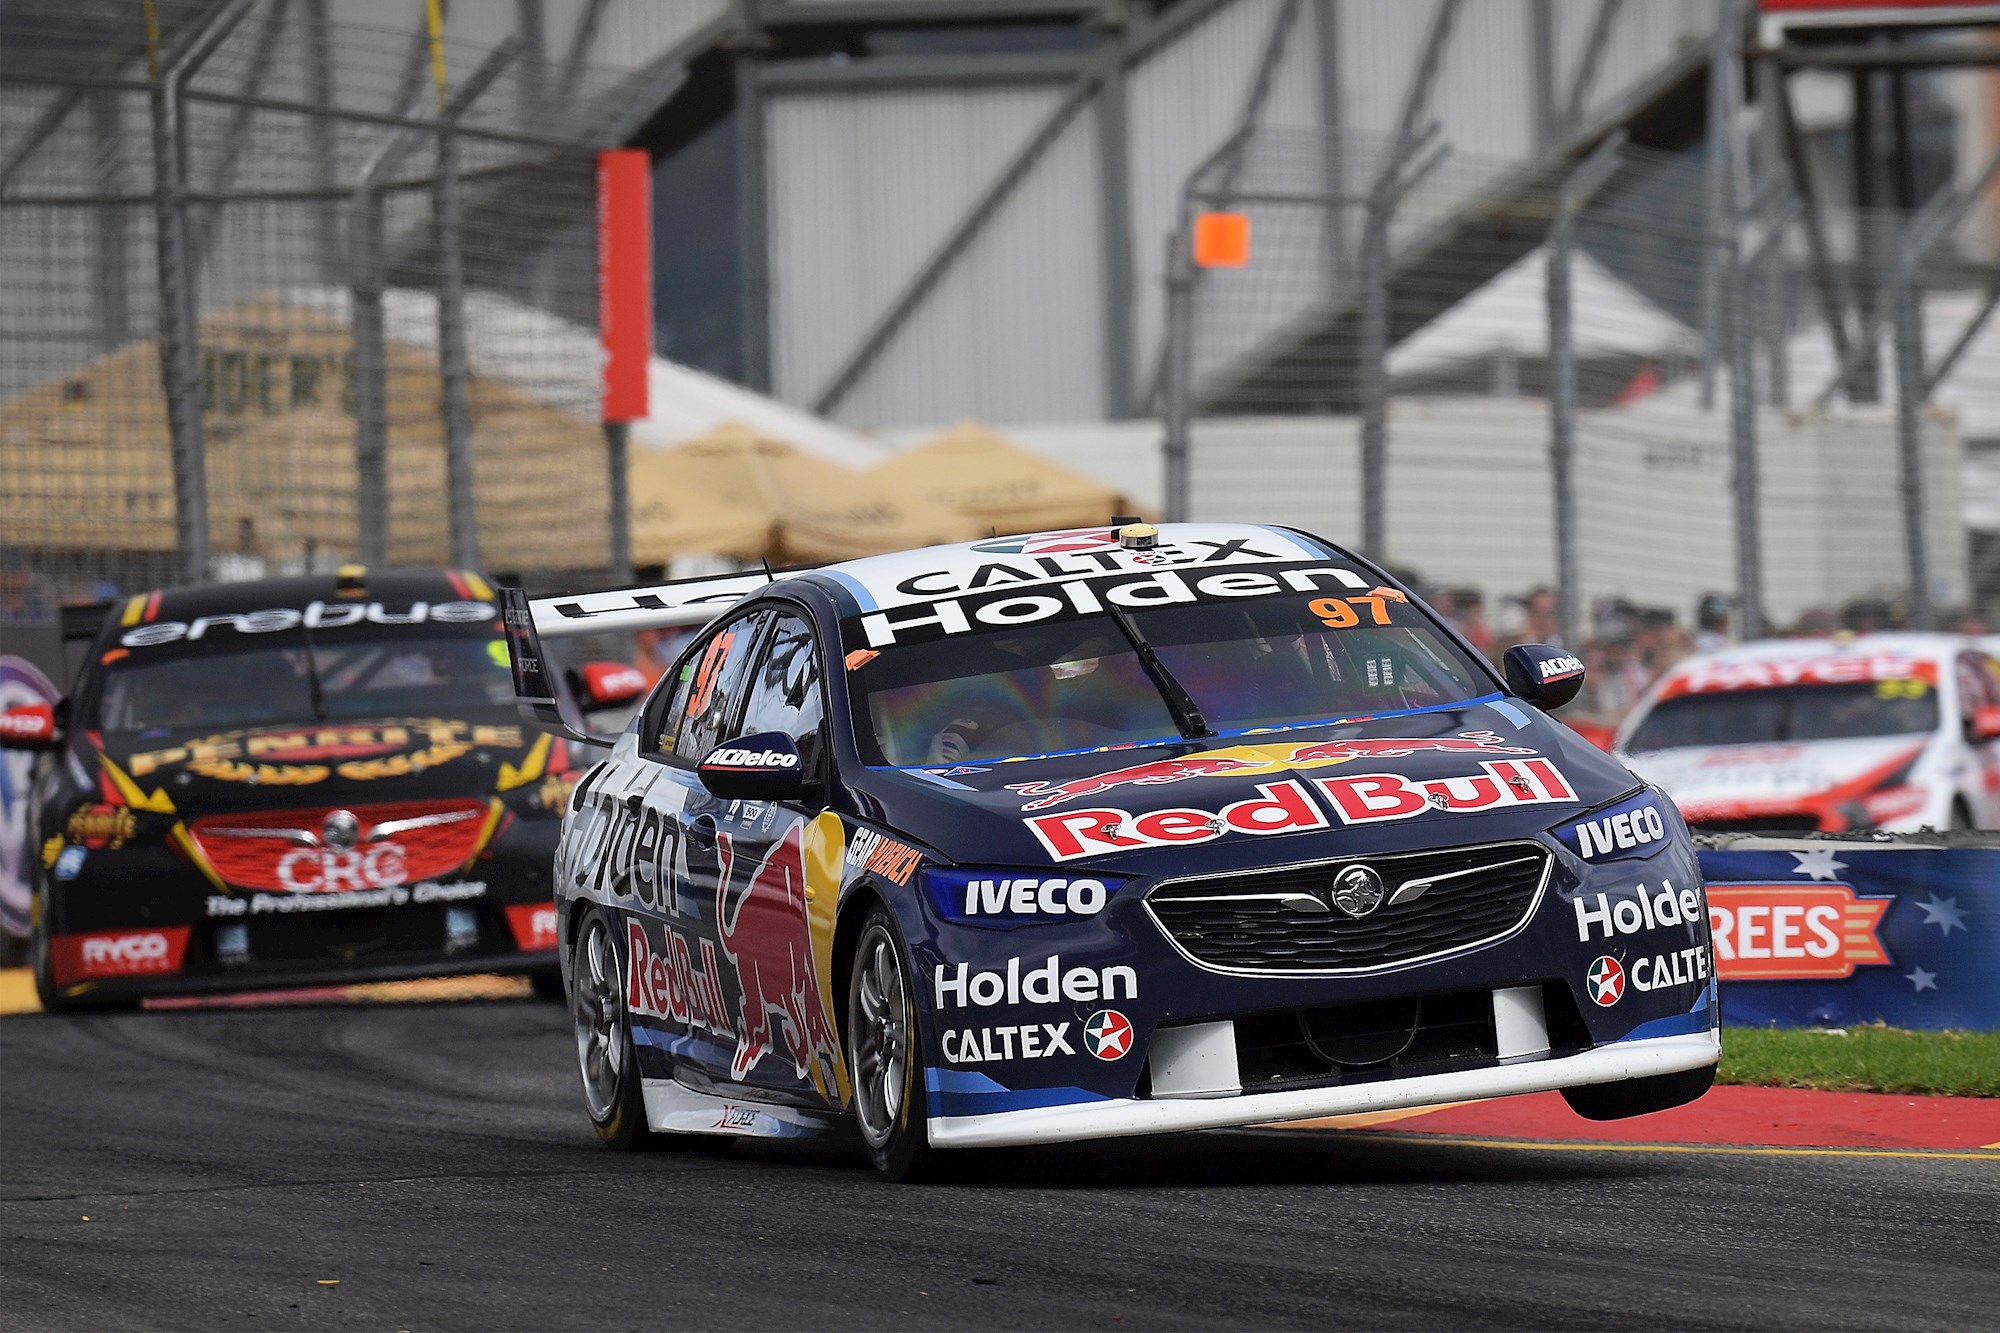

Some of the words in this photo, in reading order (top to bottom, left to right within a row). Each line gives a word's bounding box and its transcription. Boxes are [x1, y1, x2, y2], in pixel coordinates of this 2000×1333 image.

[896, 538, 1283, 596] CALTEX
[120, 600, 497, 648] erebus
[861, 566, 1371, 648] Holden
[1308, 595, 1393, 629] 97
[687, 631, 737, 718] 97
[128, 725, 524, 778] PENRITE
[703, 748, 798, 768] ACDelco
[1022, 779, 1330, 863] Red
[1315, 757, 1580, 825] Bull
[1575, 806, 1665, 859] IVECO
[277, 841, 408, 893] CRC
[846, 826, 923, 887] GEARWRENCH
[206, 894, 248, 917] The
[965, 878, 1107, 916] IVECO
[82, 932, 168, 961] RYCO
[1631, 944, 1711, 992] CALTE
[626, 916, 690, 1025] Red
[672, 931, 737, 1040] Bull
[935, 954, 1138, 1010] Holden
[942, 1020, 1077, 1063] CALTEX
